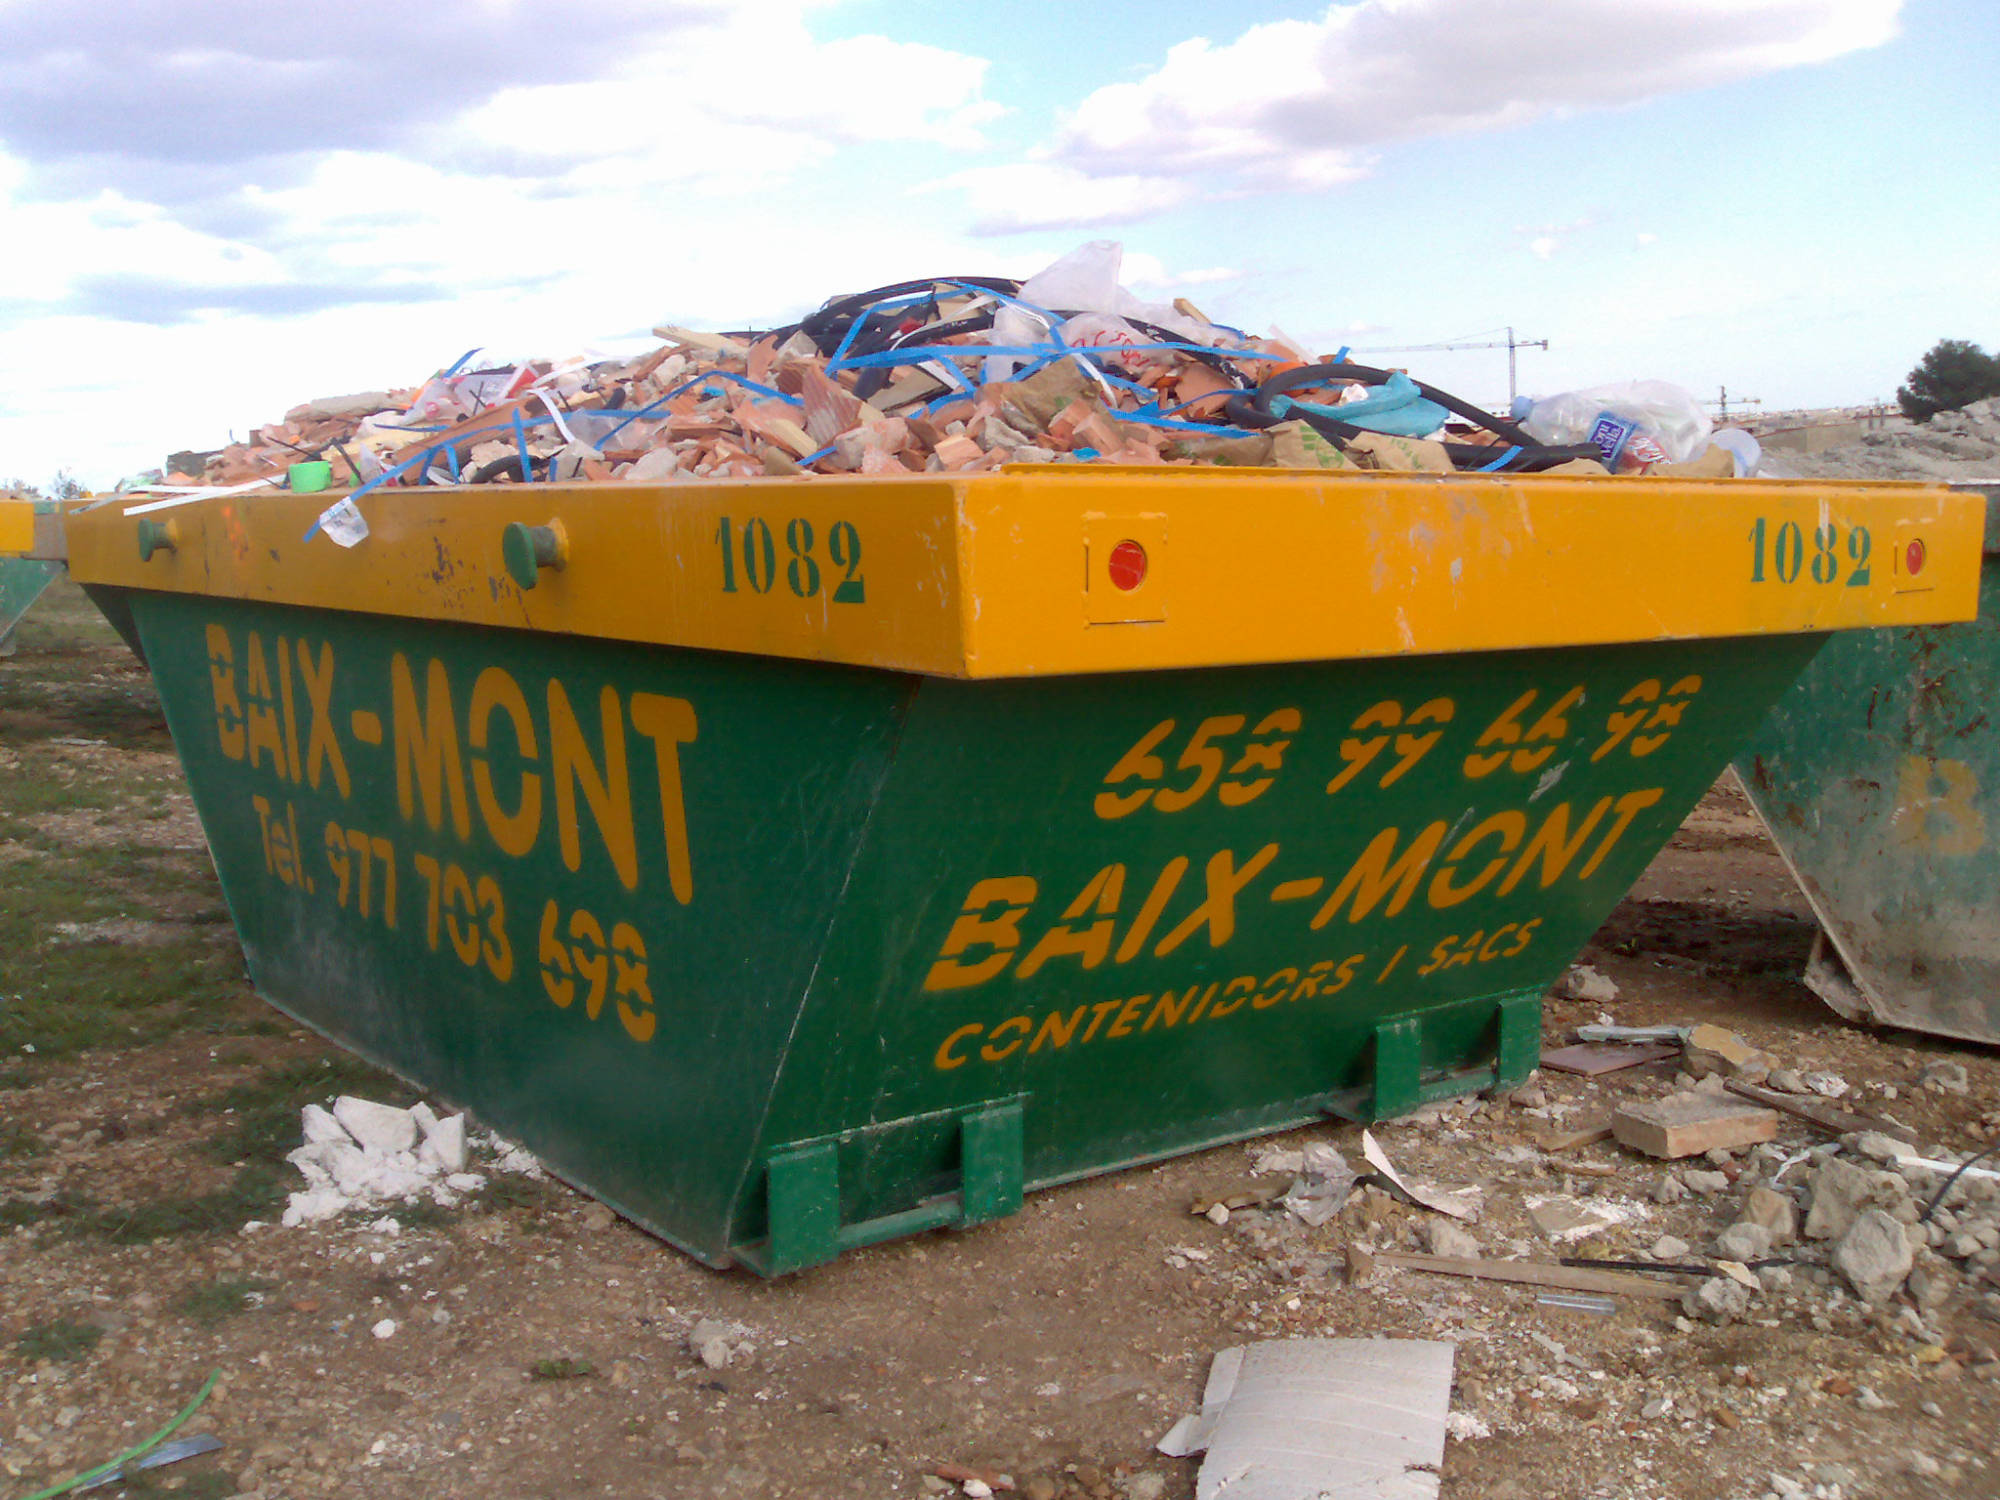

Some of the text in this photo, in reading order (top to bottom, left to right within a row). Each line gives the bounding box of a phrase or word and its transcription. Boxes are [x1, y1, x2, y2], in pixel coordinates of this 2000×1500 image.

[714, 516, 866, 604] 1082
[1748, 517, 1872, 588] 1082
[205, 623, 699, 905] BAIX-MONT
[1093, 674, 1703, 820] 658 99 66 98
[253, 794, 657, 1043] Tel. 977 703 698
[922, 787, 1665, 992] BAIX-MONT
[933, 954, 1366, 1071] CONTENIDORS
[1417, 917, 1544, 977] SACS
